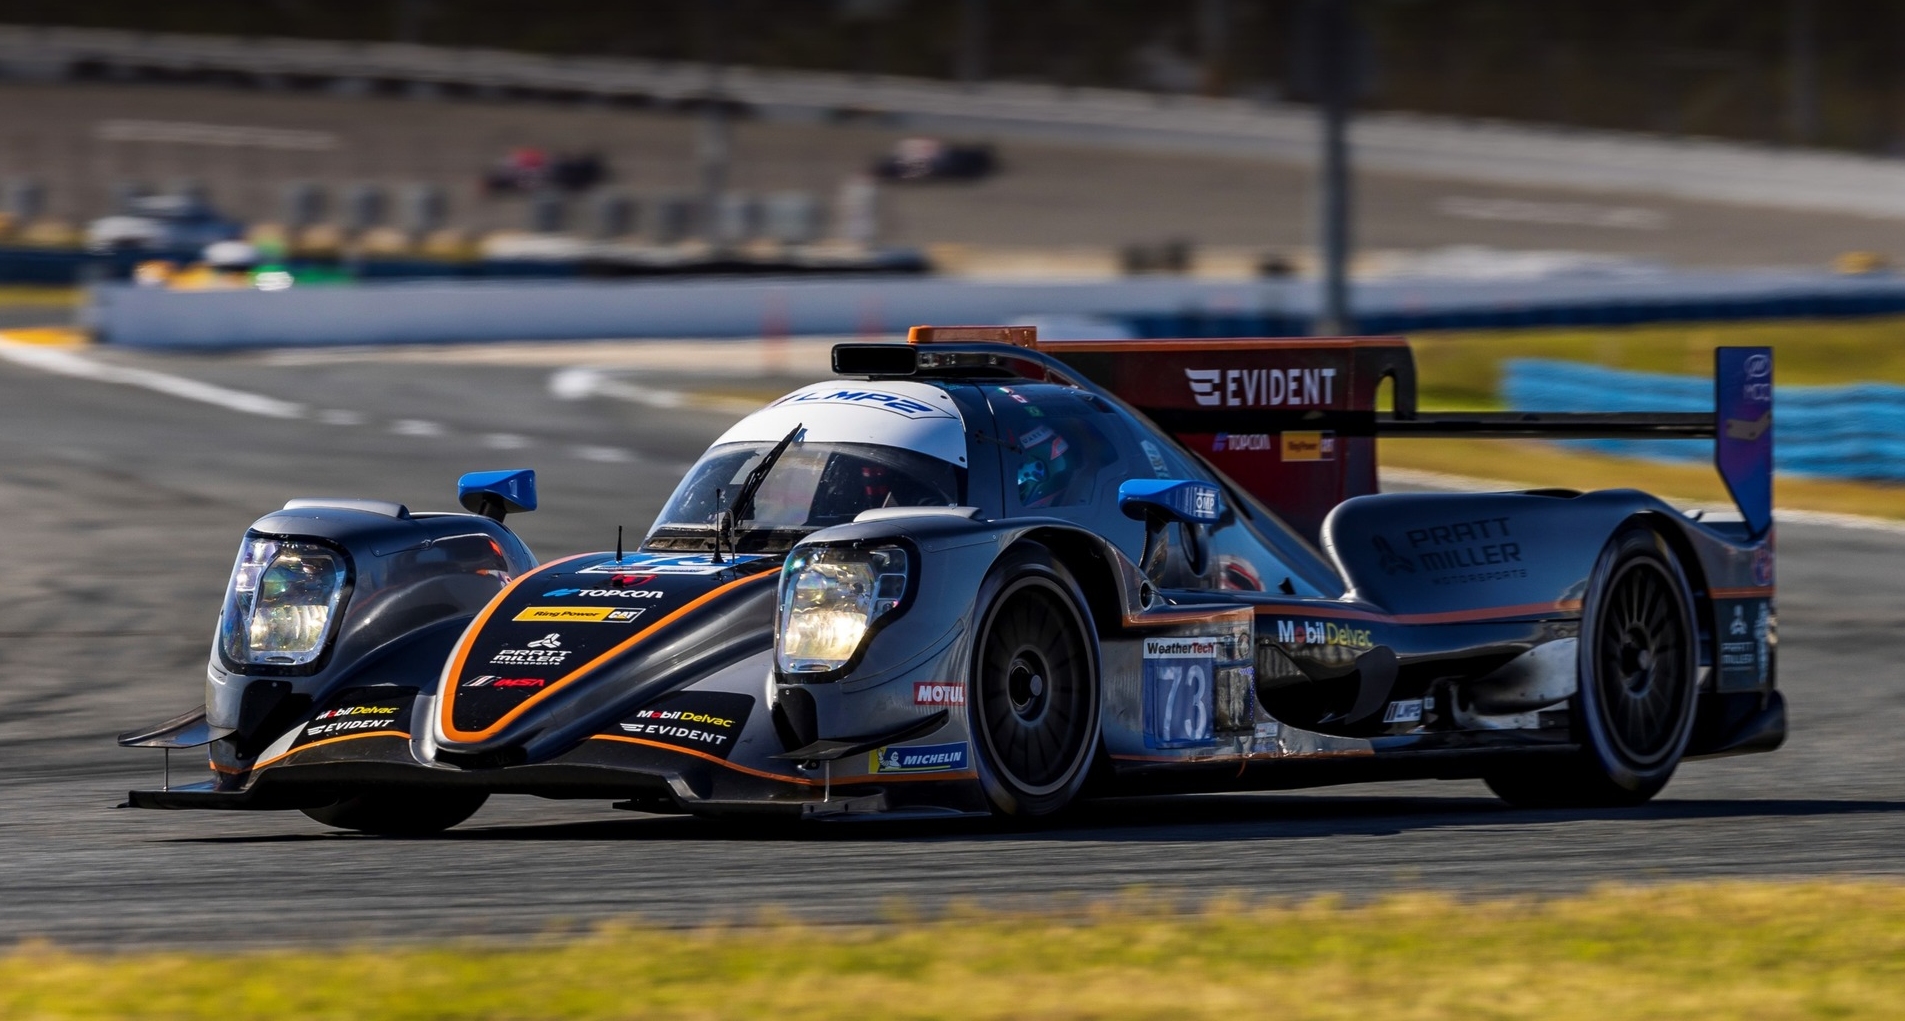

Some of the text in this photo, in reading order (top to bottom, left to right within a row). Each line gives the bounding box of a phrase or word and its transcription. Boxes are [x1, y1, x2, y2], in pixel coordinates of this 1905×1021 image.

[1226, 368, 1337, 406] EVIDENT
[1227, 433, 1271, 451] TOPCON
[1195, 496, 1215, 510] OMP
[1406, 517, 1510, 548] PRATT
[1419, 542, 1522, 571] MILLER
[1432, 569, 1528, 585] MOTORSPORTS
[579, 589, 664, 599] TOPCON
[533, 610, 558, 618] Ring
[608, 610, 636, 620] CAT
[1277, 620, 1373, 647] Mobil Delvac
[1147, 642, 1214, 654] WeatherTech
[493, 678, 545, 687] IMSA
[917, 685, 964, 703] MOTUL
[1157, 664, 1207, 742] 73
[316, 706, 397, 720] Mobil Delvac
[636, 710, 733, 728] Mobil Delvac
[324, 719, 394, 732] EVIDENT
[645, 725, 727, 745] EVIDENT
[903, 751, 962, 765] MICHELIN
